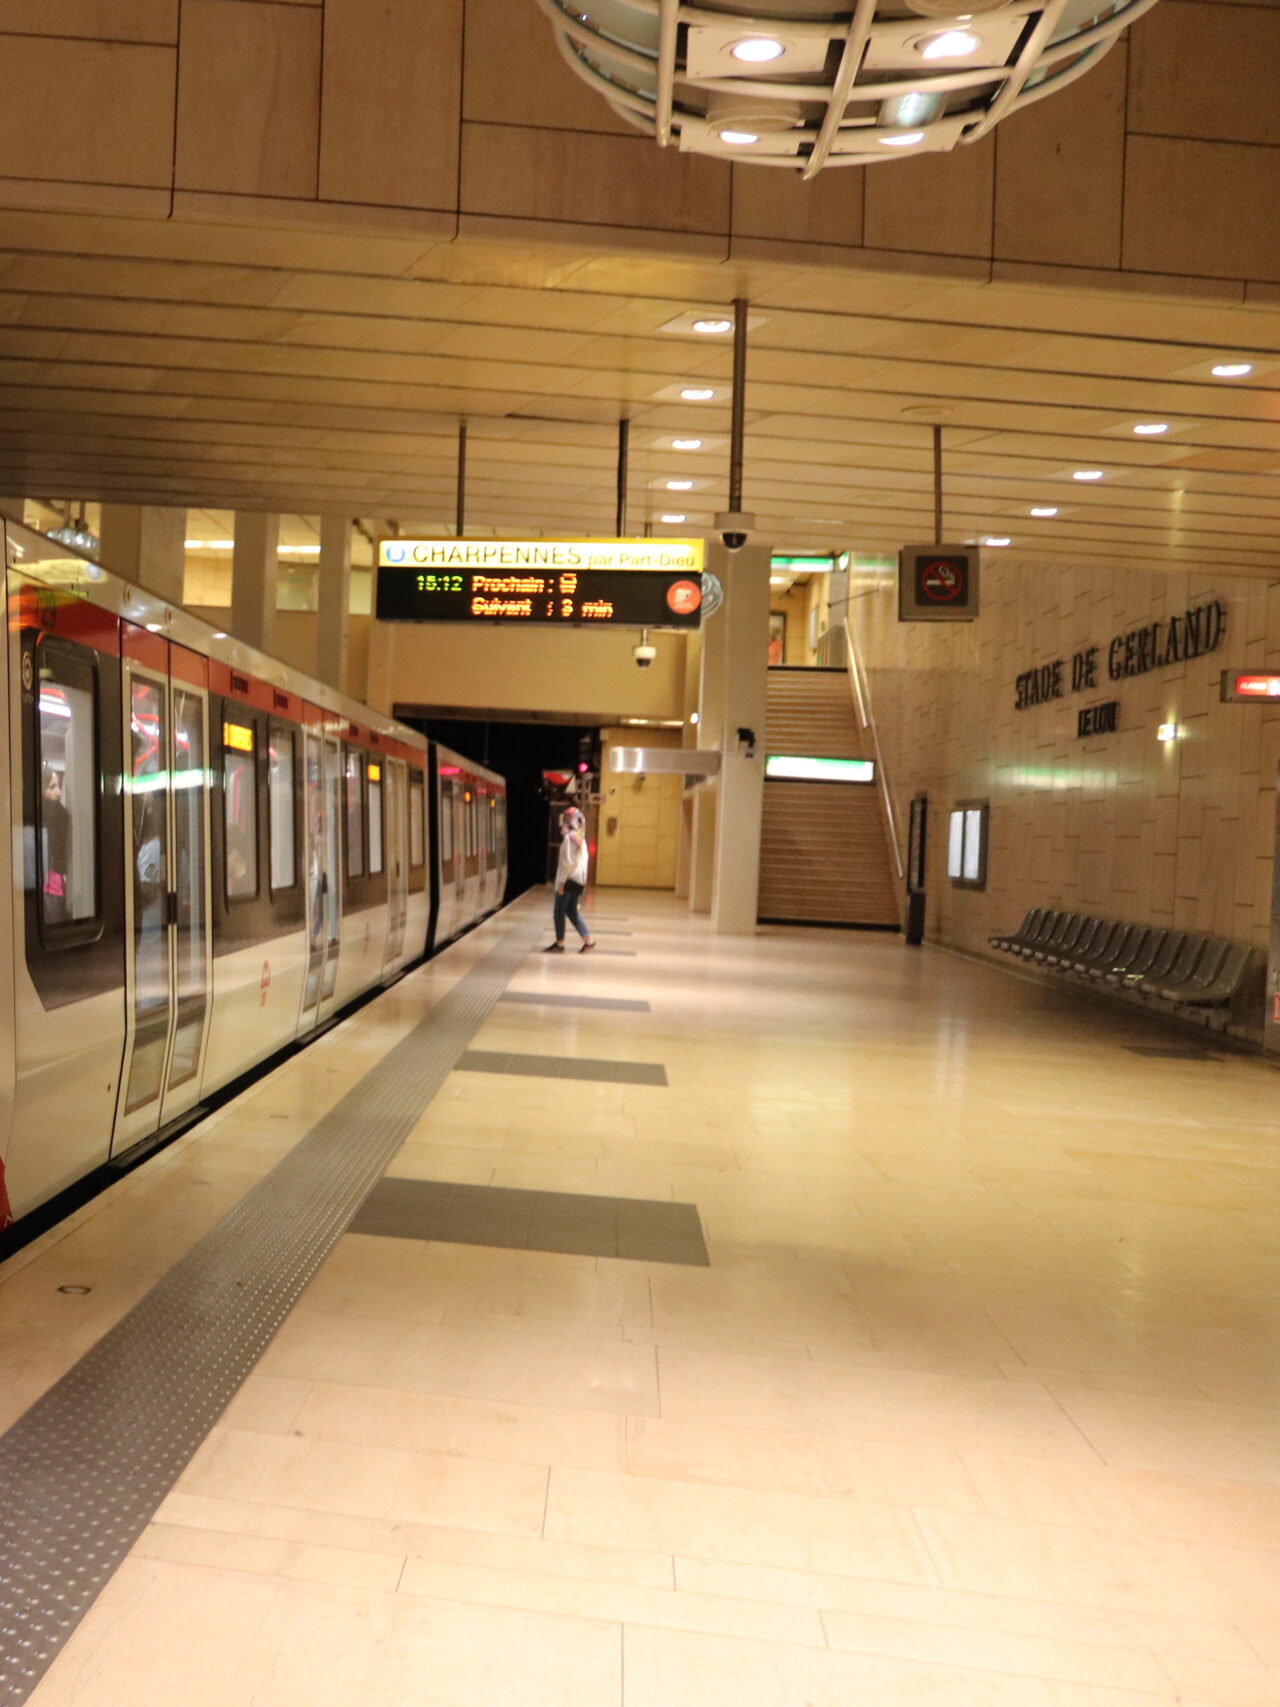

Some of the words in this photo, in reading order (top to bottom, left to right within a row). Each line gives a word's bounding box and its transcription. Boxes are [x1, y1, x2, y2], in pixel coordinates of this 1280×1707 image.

[412, 544, 581, 566] CHARPENNES
[588, 555, 612, 569] par
[619, 553, 696, 567] Part-Dieu
[416, 574, 463, 591] 15:12
[471, 597, 532, 616] Suivant
[561, 598, 574, 618] 3
[581, 599, 614, 618] min
[1014, 659, 1064, 711] STADE
[1072, 646, 1099, 692] DE
[1108, 600, 1228, 681] GERLAND
